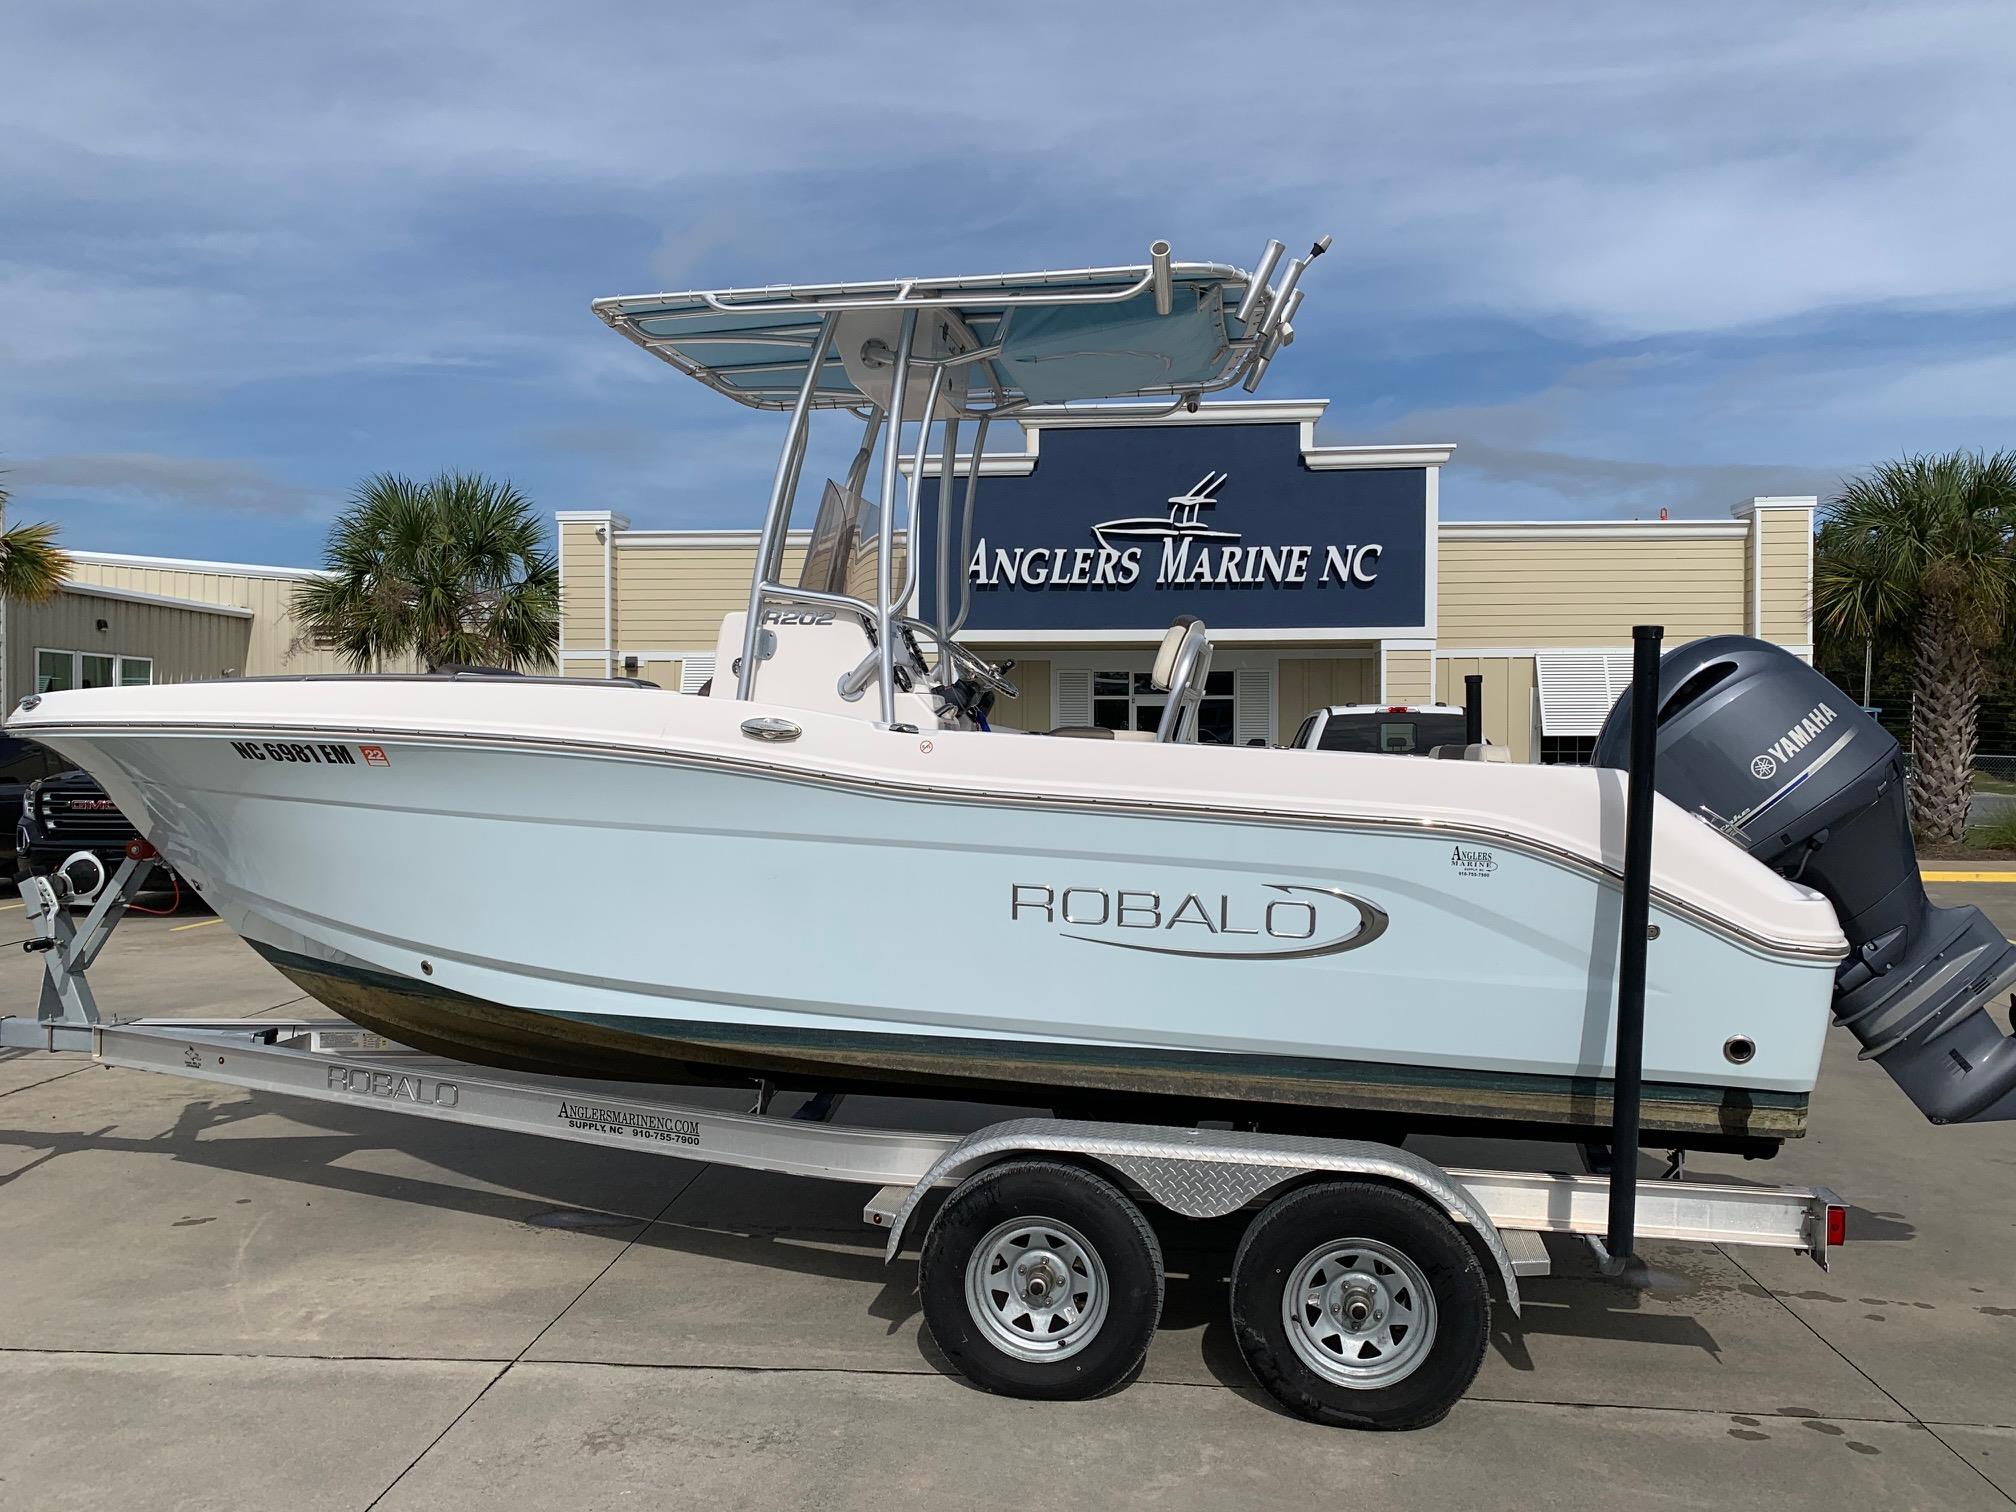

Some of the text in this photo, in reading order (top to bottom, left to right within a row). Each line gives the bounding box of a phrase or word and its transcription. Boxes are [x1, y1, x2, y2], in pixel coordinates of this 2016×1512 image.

[968, 536, 1383, 585] ANGLERS MARINE NC
[762, 609, 837, 626] R202
[1767, 702, 1838, 764] YAMAHA
[230, 741, 356, 765] NC 6981 EM
[366, 749, 385, 760] 22
[1451, 845, 1493, 862] ANGLERS
[1451, 860, 1492, 868] MARINE
[1011, 882, 1317, 940] ROBALO
[327, 1065, 459, 1108] ROBALO
[558, 1101, 700, 1135] ANGLERSMARINENC.COM
[568, 1119, 700, 1146] SUPPLY, NC 910-755-7900
